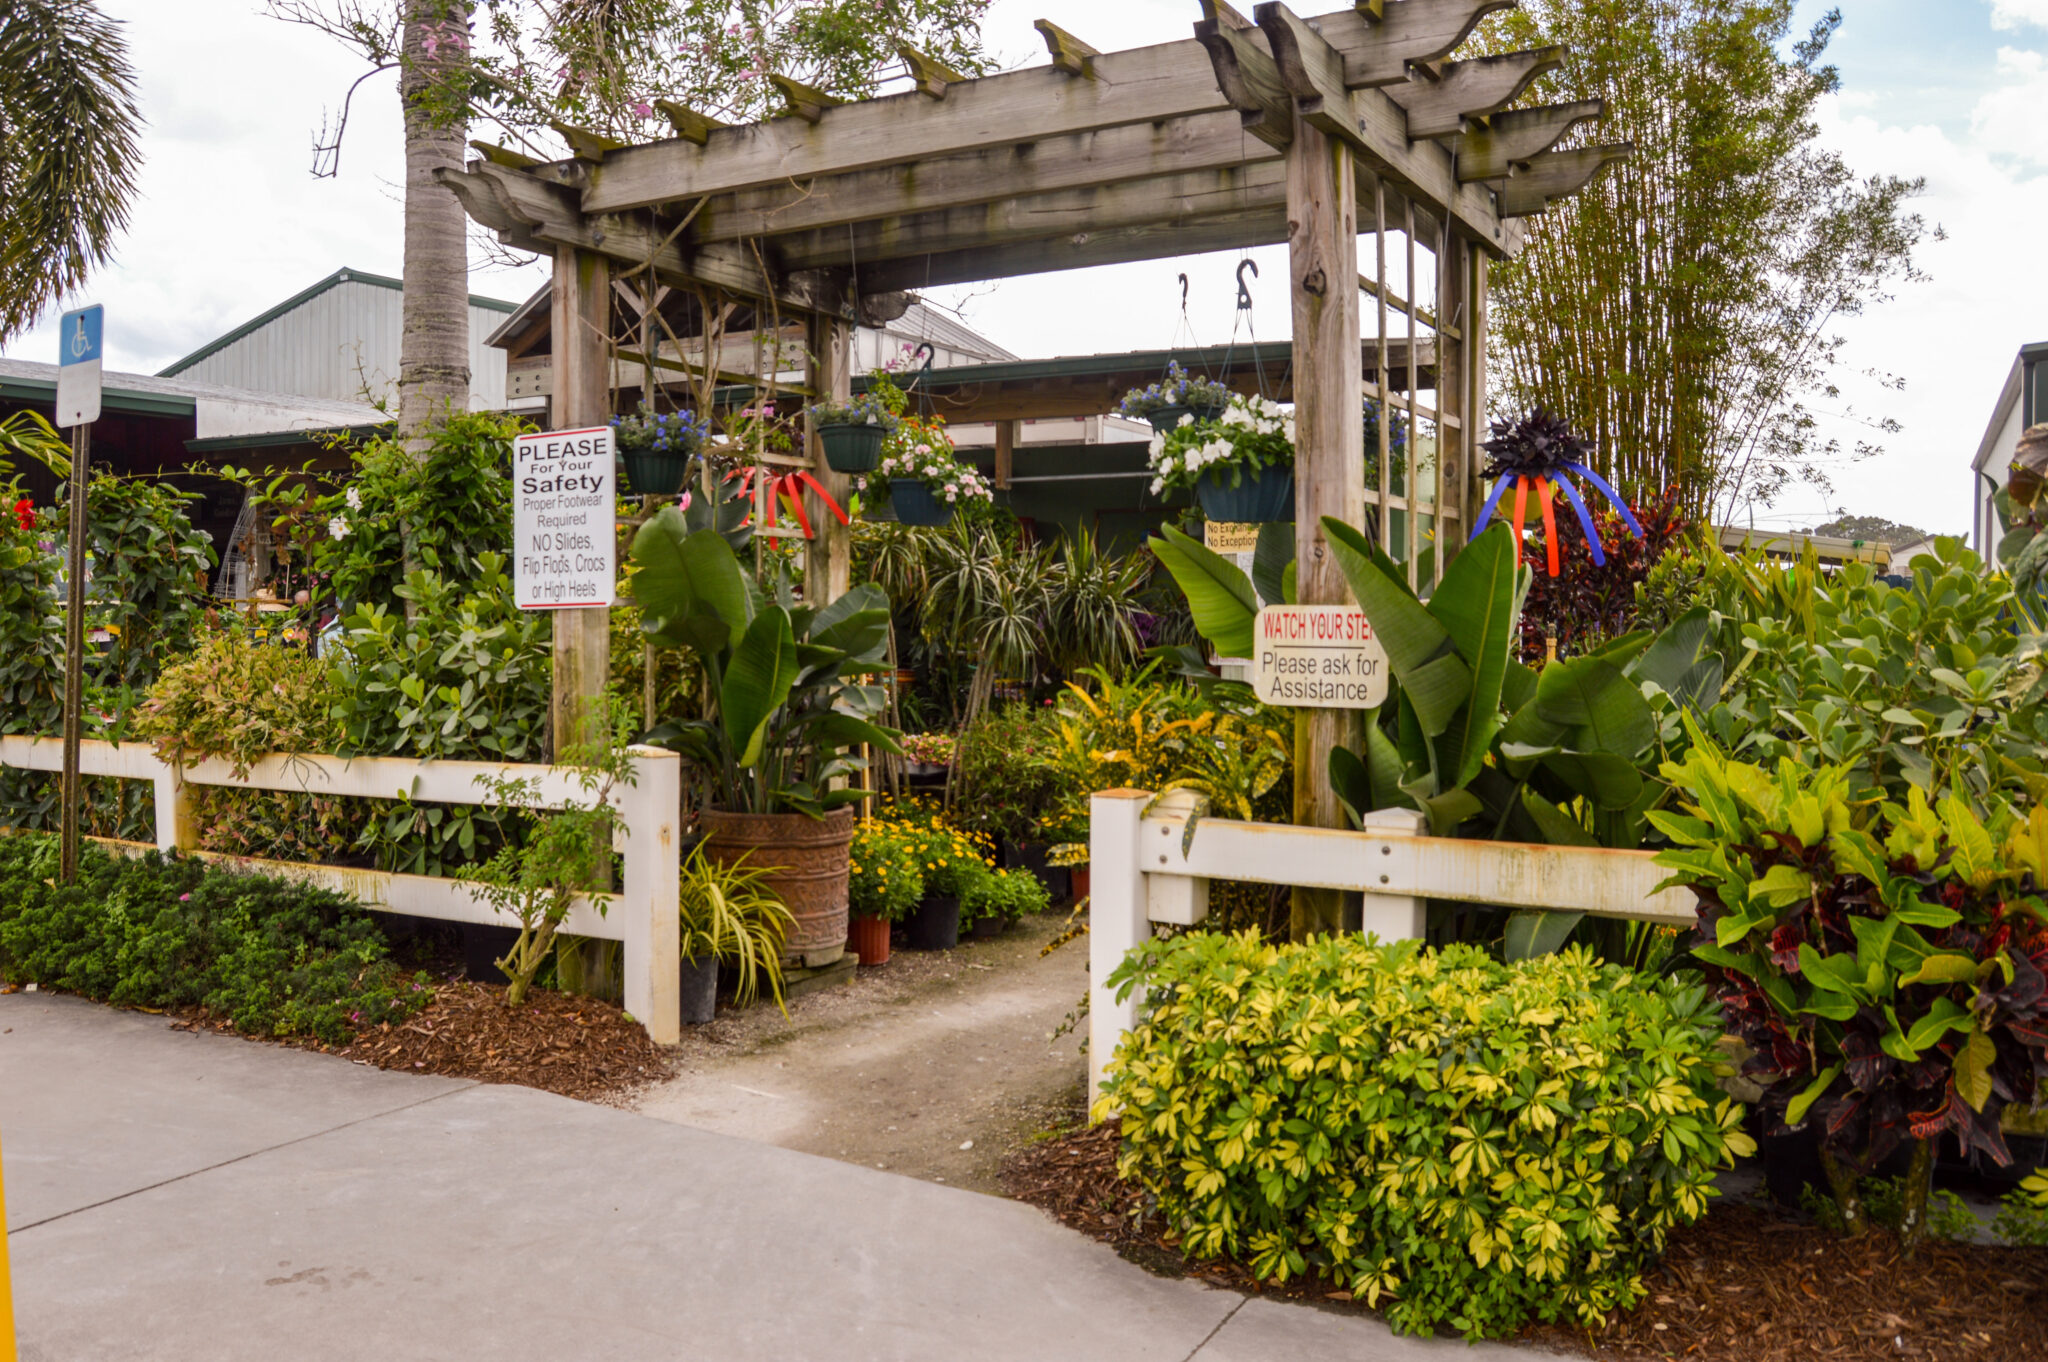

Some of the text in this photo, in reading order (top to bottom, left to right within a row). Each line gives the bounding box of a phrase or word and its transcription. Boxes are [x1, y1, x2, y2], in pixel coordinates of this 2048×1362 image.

[519, 438, 607, 463] PLEASE
[530, 461, 593, 474] For Your
[522, 474, 604, 494] Safety
[523, 494, 603, 513] Proper Footwear
[537, 512, 587, 530] Required
[1207, 523, 1218, 534] No
[532, 532, 594, 552] NO Slides,
[1207, 537, 1218, 548] No
[523, 553, 606, 579] Flip Flops, Crocs
[532, 580, 597, 602] or High Heels
[1263, 612, 1305, 640] WATCH
[1310, 612, 1343, 640] YOUR
[1262, 651, 1379, 676] Please ask for
[1270, 677, 1368, 701] Assistance
